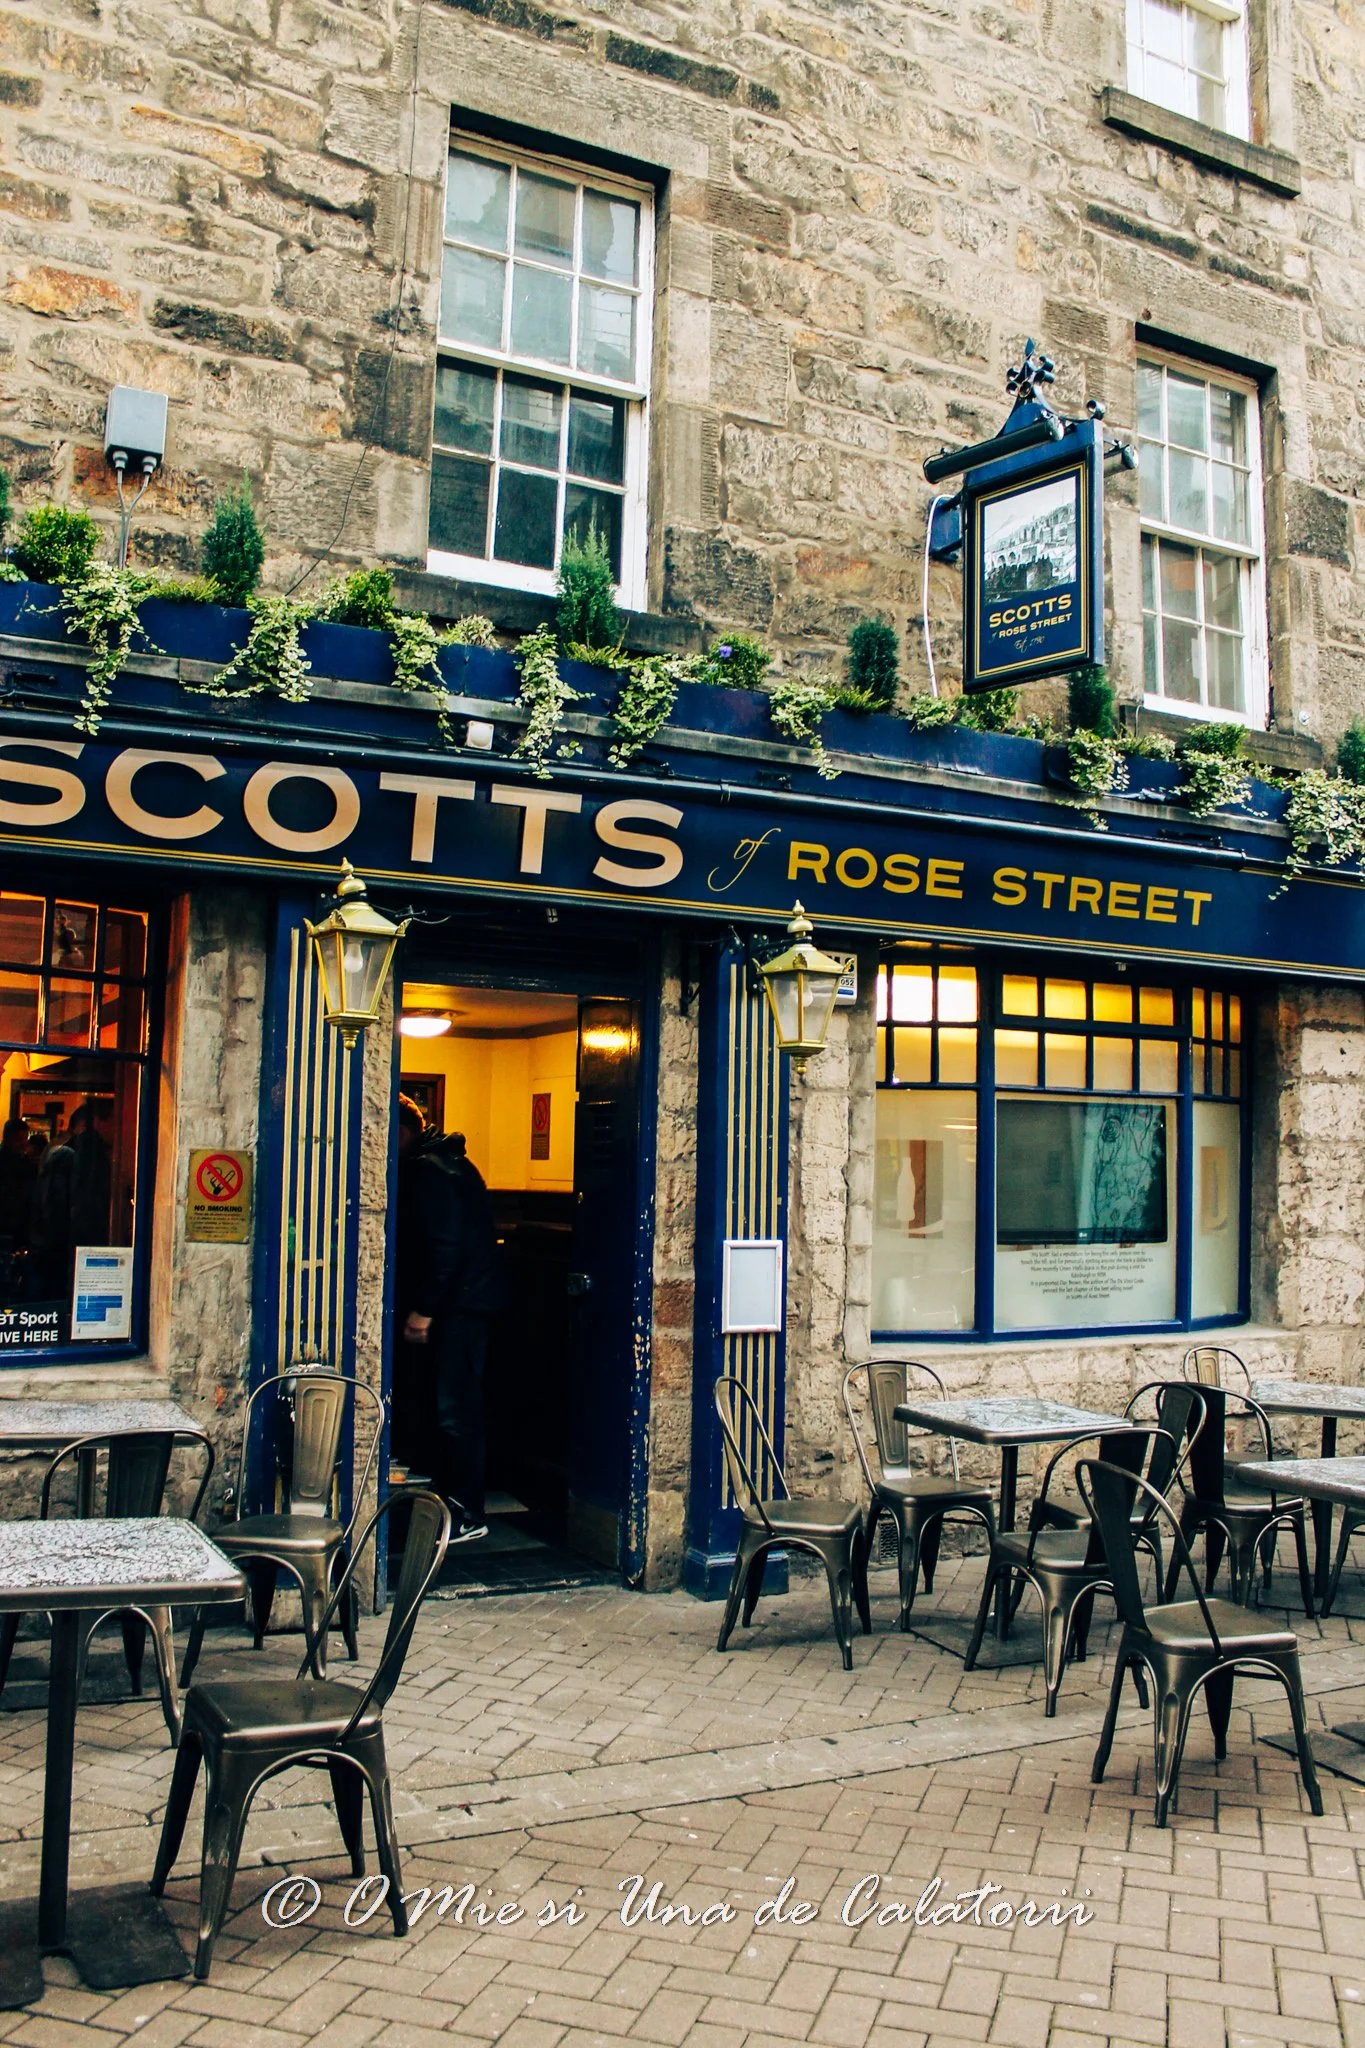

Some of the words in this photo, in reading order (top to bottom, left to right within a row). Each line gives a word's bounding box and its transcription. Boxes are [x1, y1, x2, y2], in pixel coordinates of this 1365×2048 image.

[989, 594, 1072, 628] SCOTTS
[999, 626, 1027, 639] ROSE
[1030, 613, 1073, 631] STREET
[0, 736, 684, 888] SCOTTS
[708, 827, 781, 892] of
[787, 840, 965, 899] ROSE
[992, 866, 1212, 927] STREET
[19, 1311, 58, 1327] Sport
[24, 1330, 58, 1342] HERE
